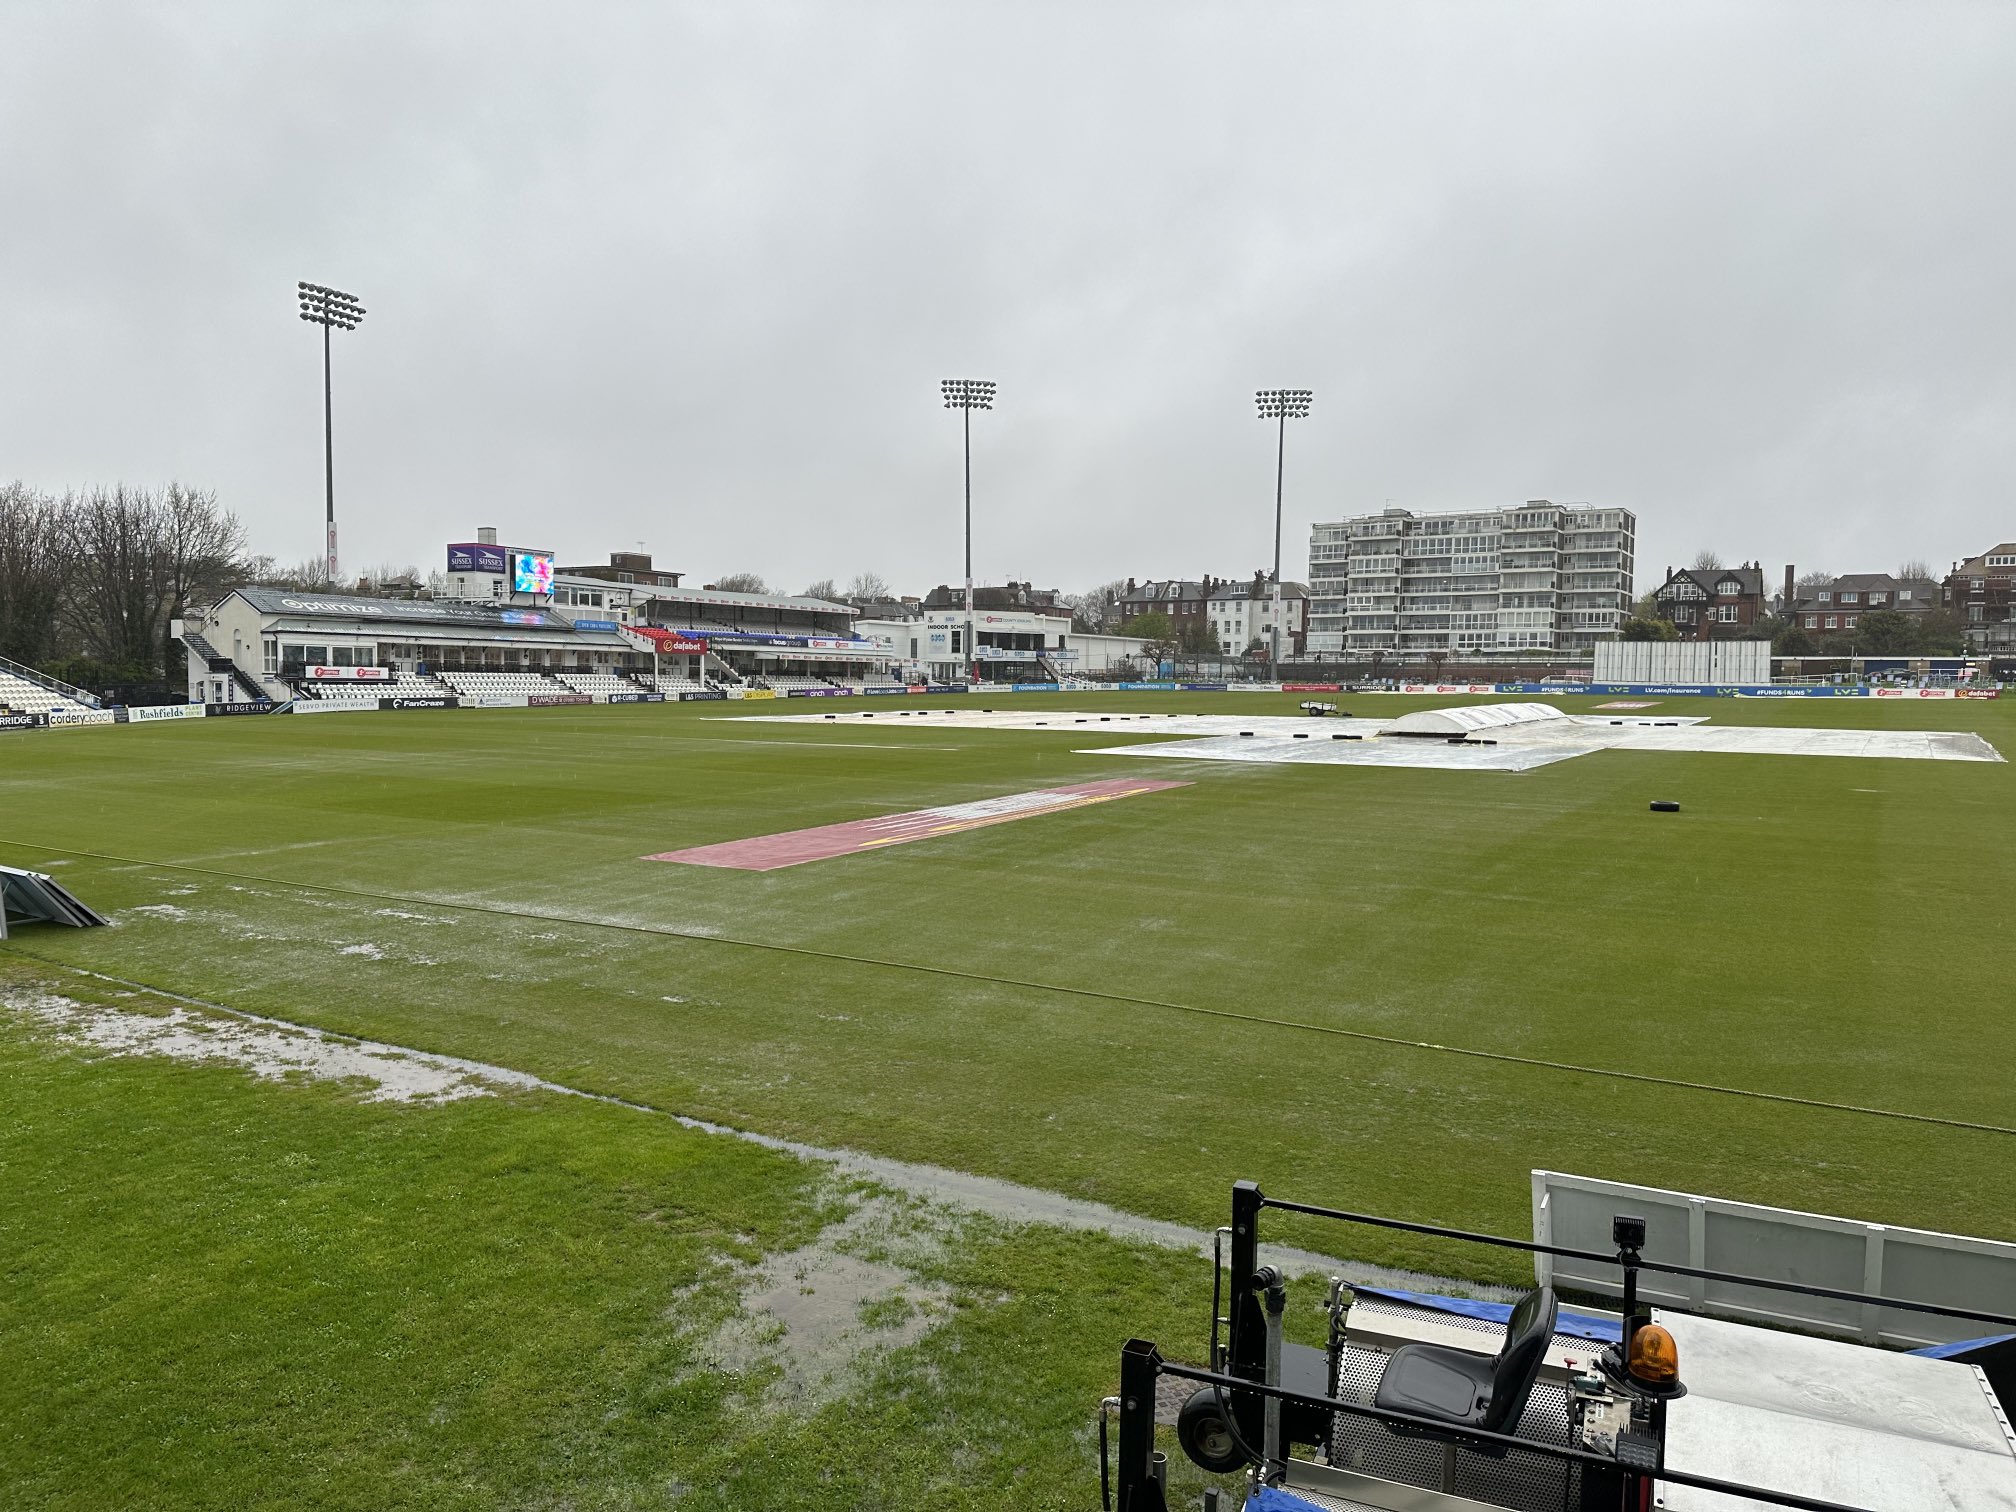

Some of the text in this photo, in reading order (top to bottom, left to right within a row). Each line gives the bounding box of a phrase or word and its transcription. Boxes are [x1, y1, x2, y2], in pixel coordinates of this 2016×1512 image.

[451, 557, 473, 565] SUSSEX
[478, 557, 504, 567] SUSSEX
[281, 598, 383, 614] Optimize
[673, 643, 701, 651] dafabet
[226, 703, 272, 712] RIDGEVIEW
[140, 707, 184, 720] Rushfields
[0, 715, 32, 725] RRIDGE
